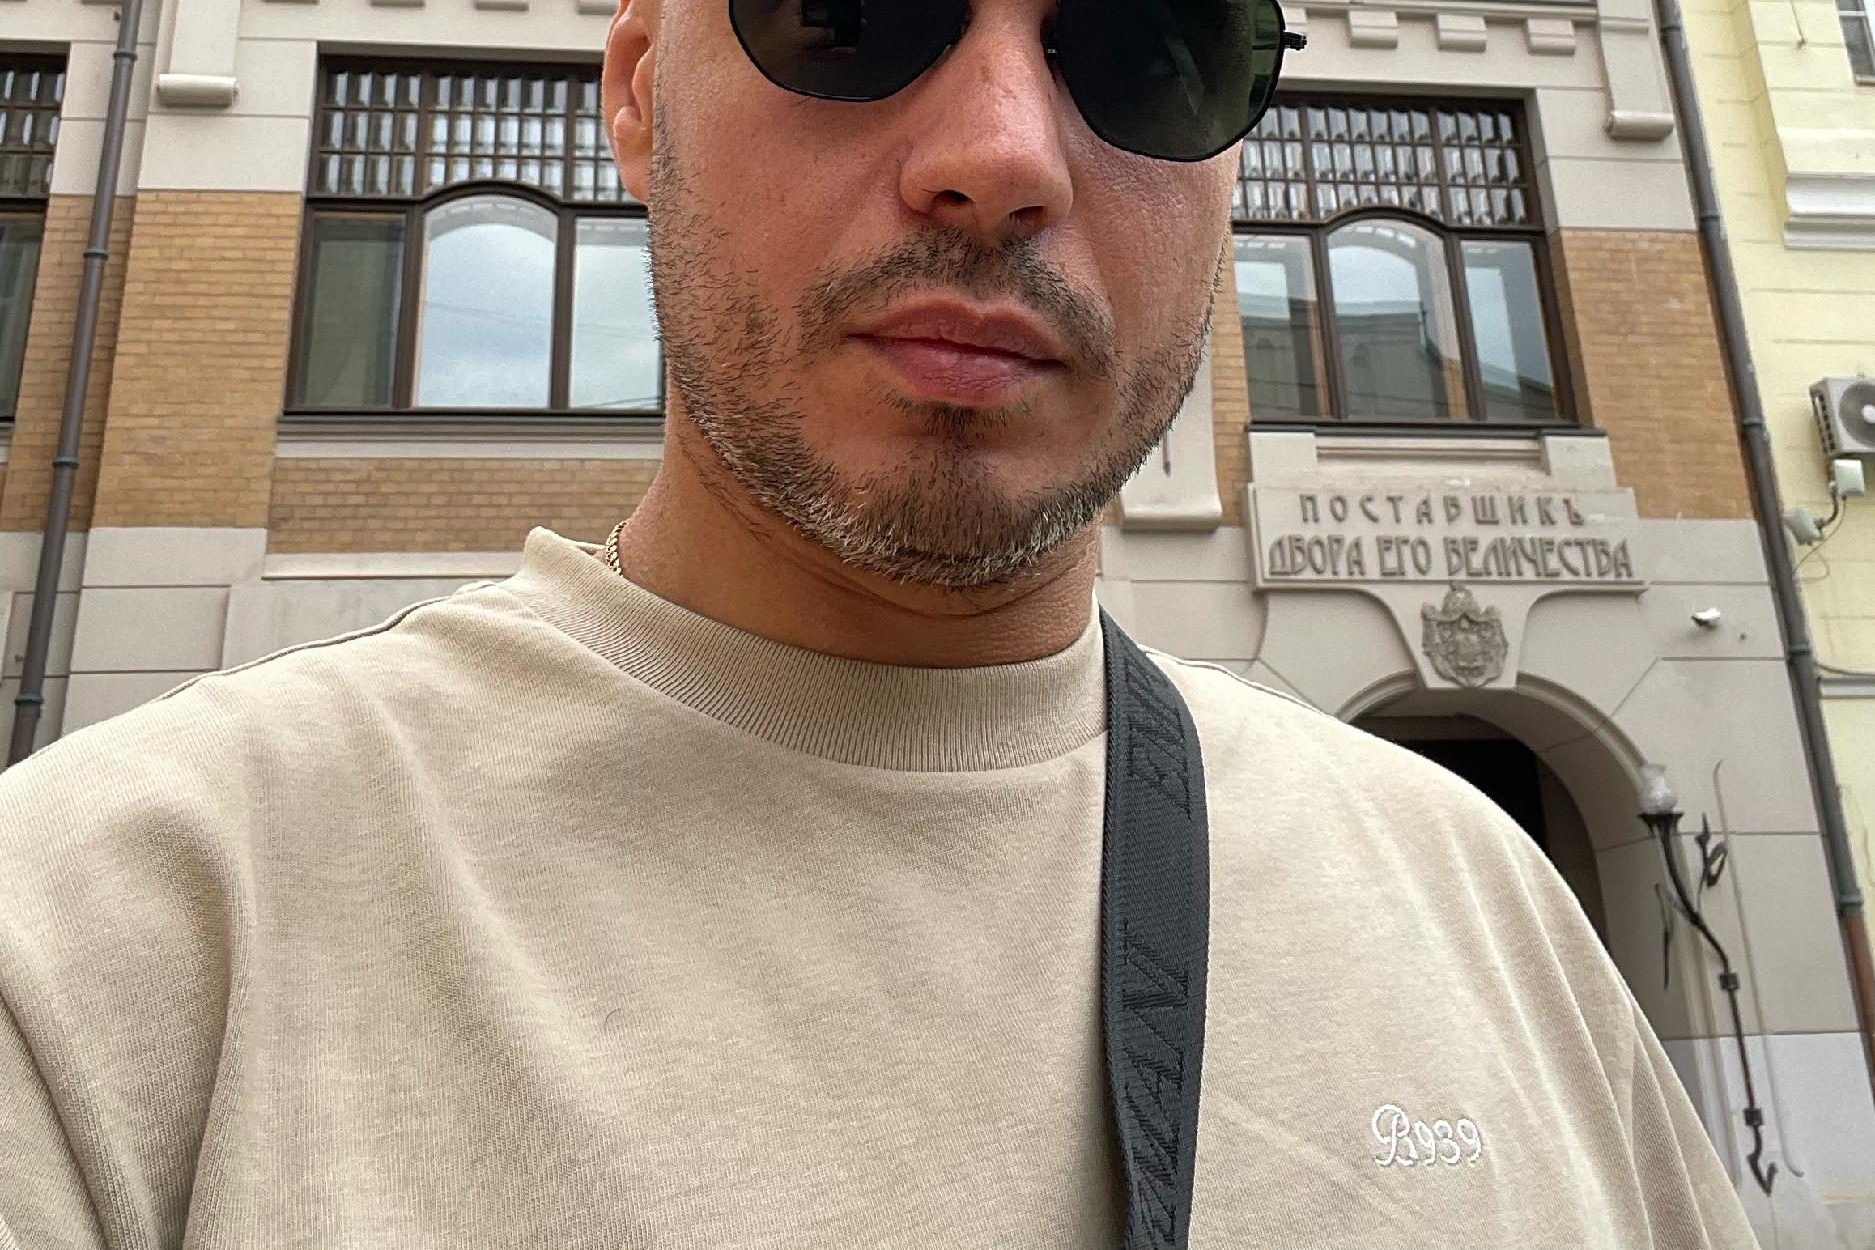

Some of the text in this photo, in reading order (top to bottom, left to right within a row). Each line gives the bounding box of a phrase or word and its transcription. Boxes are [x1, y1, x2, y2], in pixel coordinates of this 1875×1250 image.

[1299, 494, 1585, 526] ПОСТАВЩИКЪ
[1268, 534, 1633, 578] ДВОРА ЕГО ВЕЛИЧЕСТВА
